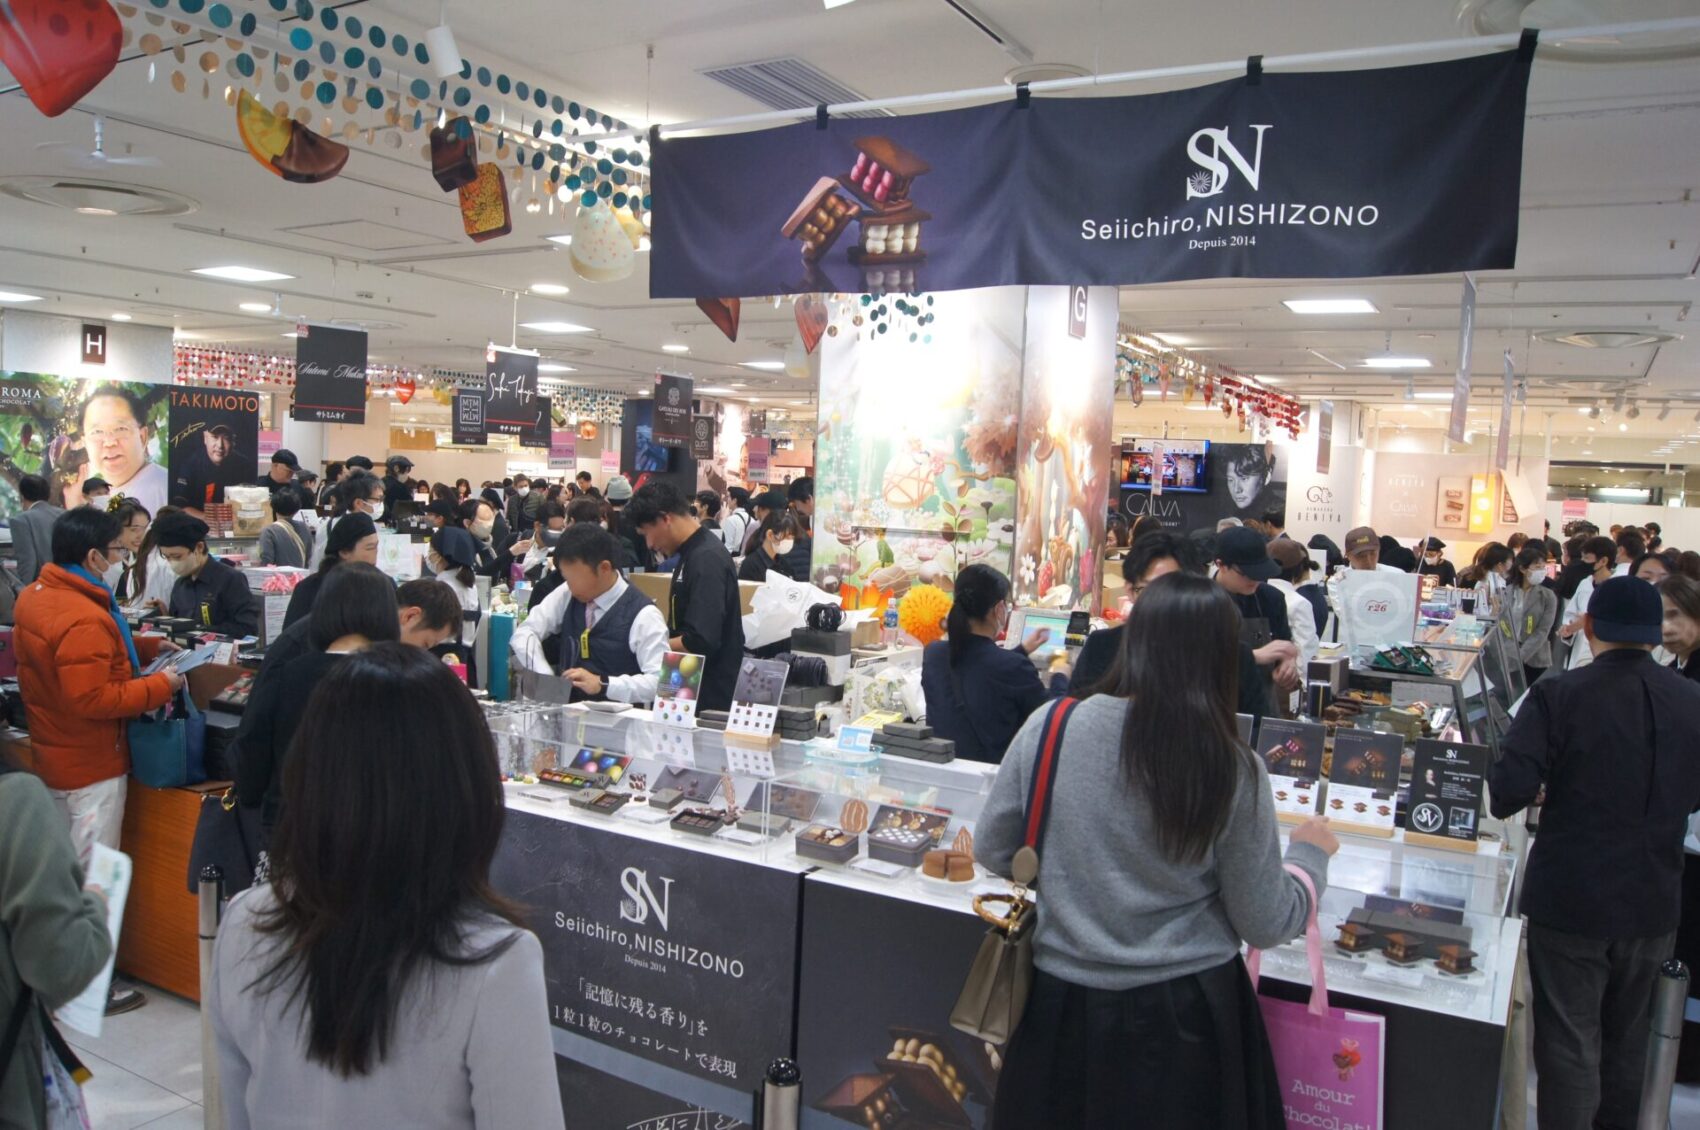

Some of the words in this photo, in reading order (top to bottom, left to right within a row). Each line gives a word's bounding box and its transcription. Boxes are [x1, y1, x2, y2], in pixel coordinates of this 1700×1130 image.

[1188, 238, 1227, 250] Depuis
[1230, 235, 1256, 247] 2014
[1075, 286, 1086, 322] G
[86, 333, 102, 355] H
[171, 391, 258, 412] TAKIMOTO
[1126, 493, 1181, 517] CALVA
[624, 954, 649, 970] Depuis
[649, 961, 667, 973] 2014
[578, 977, 709, 1037] 「記憶に残る香り」を
[1291, 1079, 1356, 1106] Amour
[1313, 1101, 1331, 1113] du
